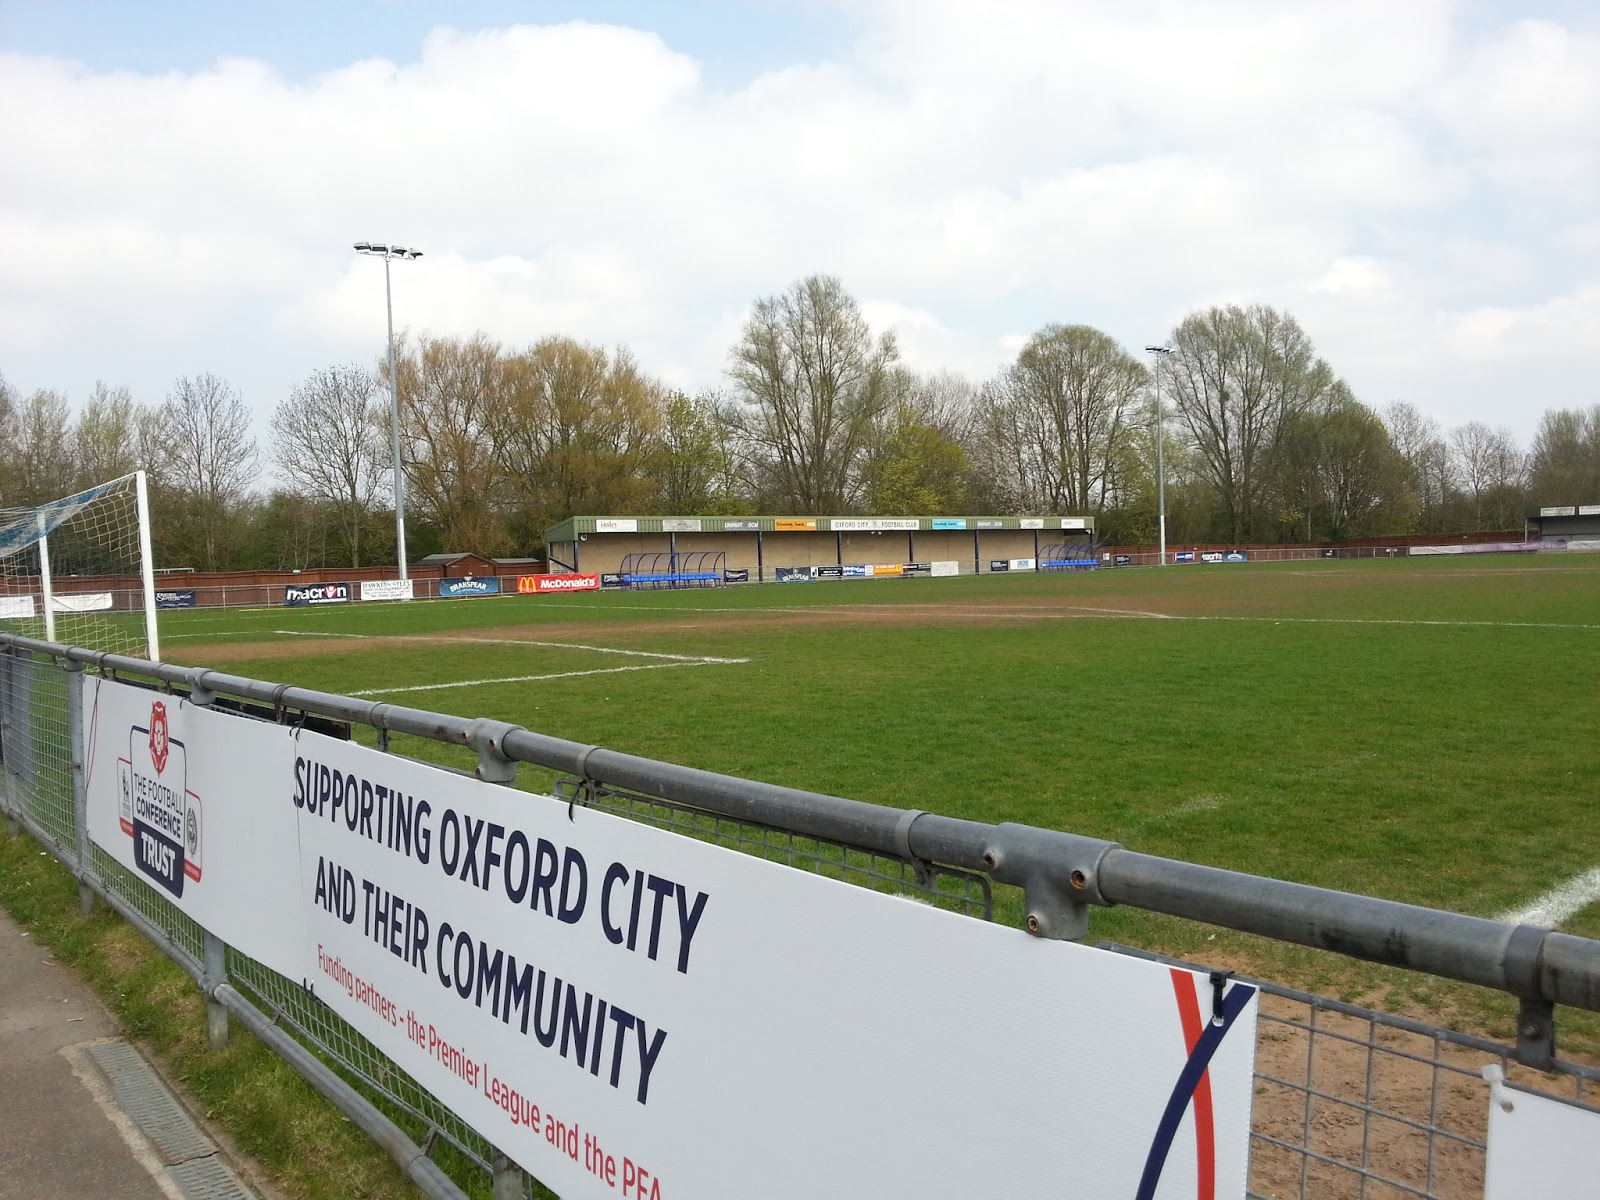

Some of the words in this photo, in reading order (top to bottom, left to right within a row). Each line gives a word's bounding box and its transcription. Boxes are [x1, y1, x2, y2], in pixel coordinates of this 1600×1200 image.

[449, 581, 487, 592] BRAKSPEAR
[541, 577, 596, 589] McDonald's
[133, 773, 147, 796] THE
[147, 779, 183, 816] FOOTBALL
[136, 796, 181, 839] CONFERENCE
[140, 830, 176, 882] TRUST
[294, 756, 431, 865] SUPPORTING
[440, 808, 588, 924] OXFORD
[601, 862, 710, 974] CITY
[314, 856, 356, 925] AND
[362, 878, 429, 974] THEIR
[436, 921, 668, 1106] COMMUNITY
[317, 943, 354, 998] Funding
[355, 977, 397, 1028] partners
[406, 1010, 426, 1050] the
[429, 1024, 480, 1090] Premier
[483, 1063, 541, 1135] League
[545, 1113, 579, 1162] and
[584, 1132, 616, 1188] the
[623, 1156, 661, 1200] PFA
